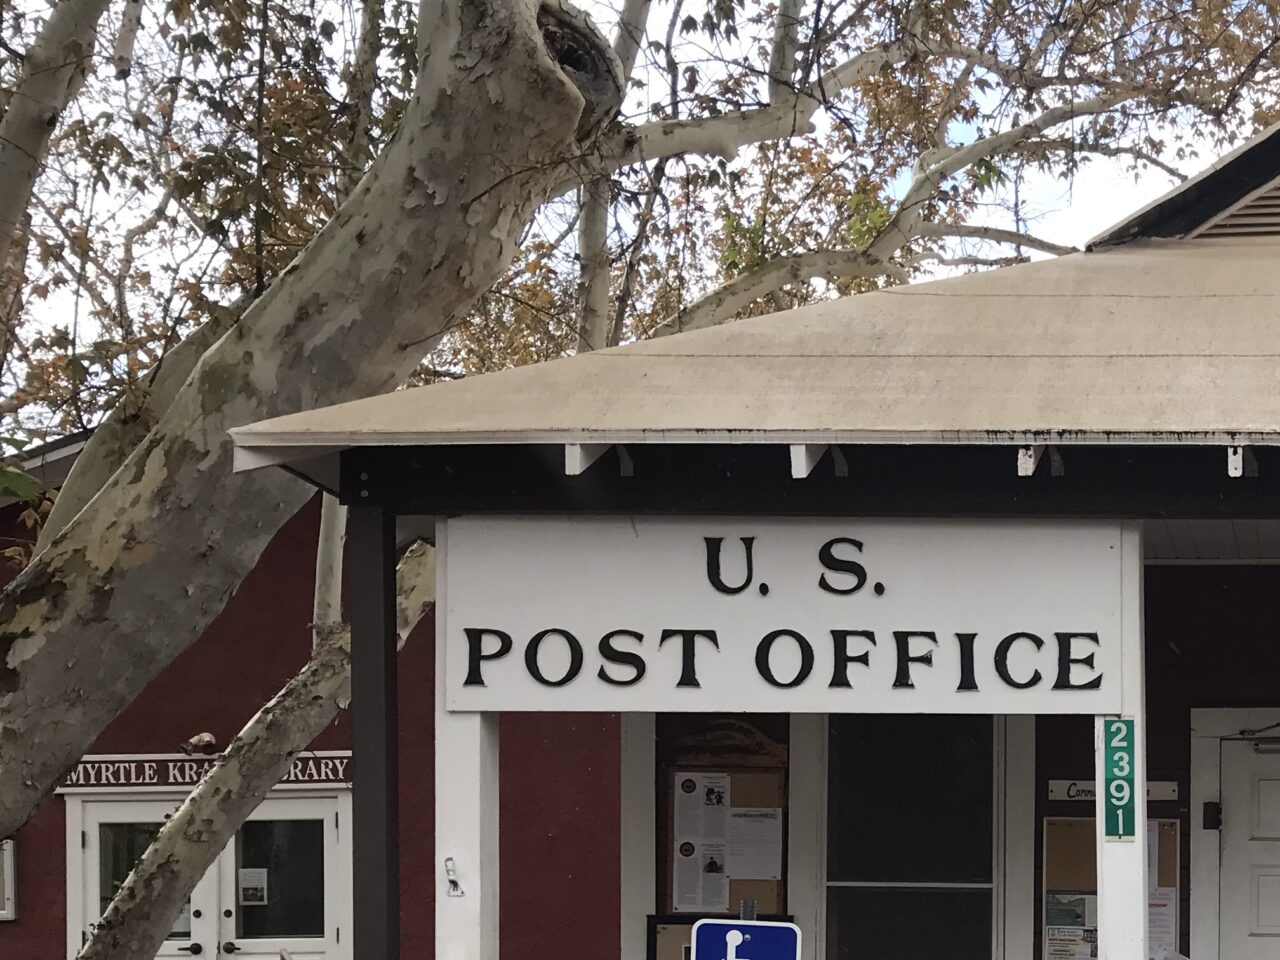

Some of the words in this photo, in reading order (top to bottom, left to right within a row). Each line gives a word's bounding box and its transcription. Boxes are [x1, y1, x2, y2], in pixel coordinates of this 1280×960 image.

[704, 536, 770, 596] U.
[817, 537, 885, 596] S.
[462, 627, 720, 689] POST
[755, 628, 1104, 692] OFFICE
[65, 762, 158, 785] MYRTLE
[168, 760, 211, 783] KRA
[282, 759, 349, 781] RARY
[1110, 722, 1131, 835] 2391
